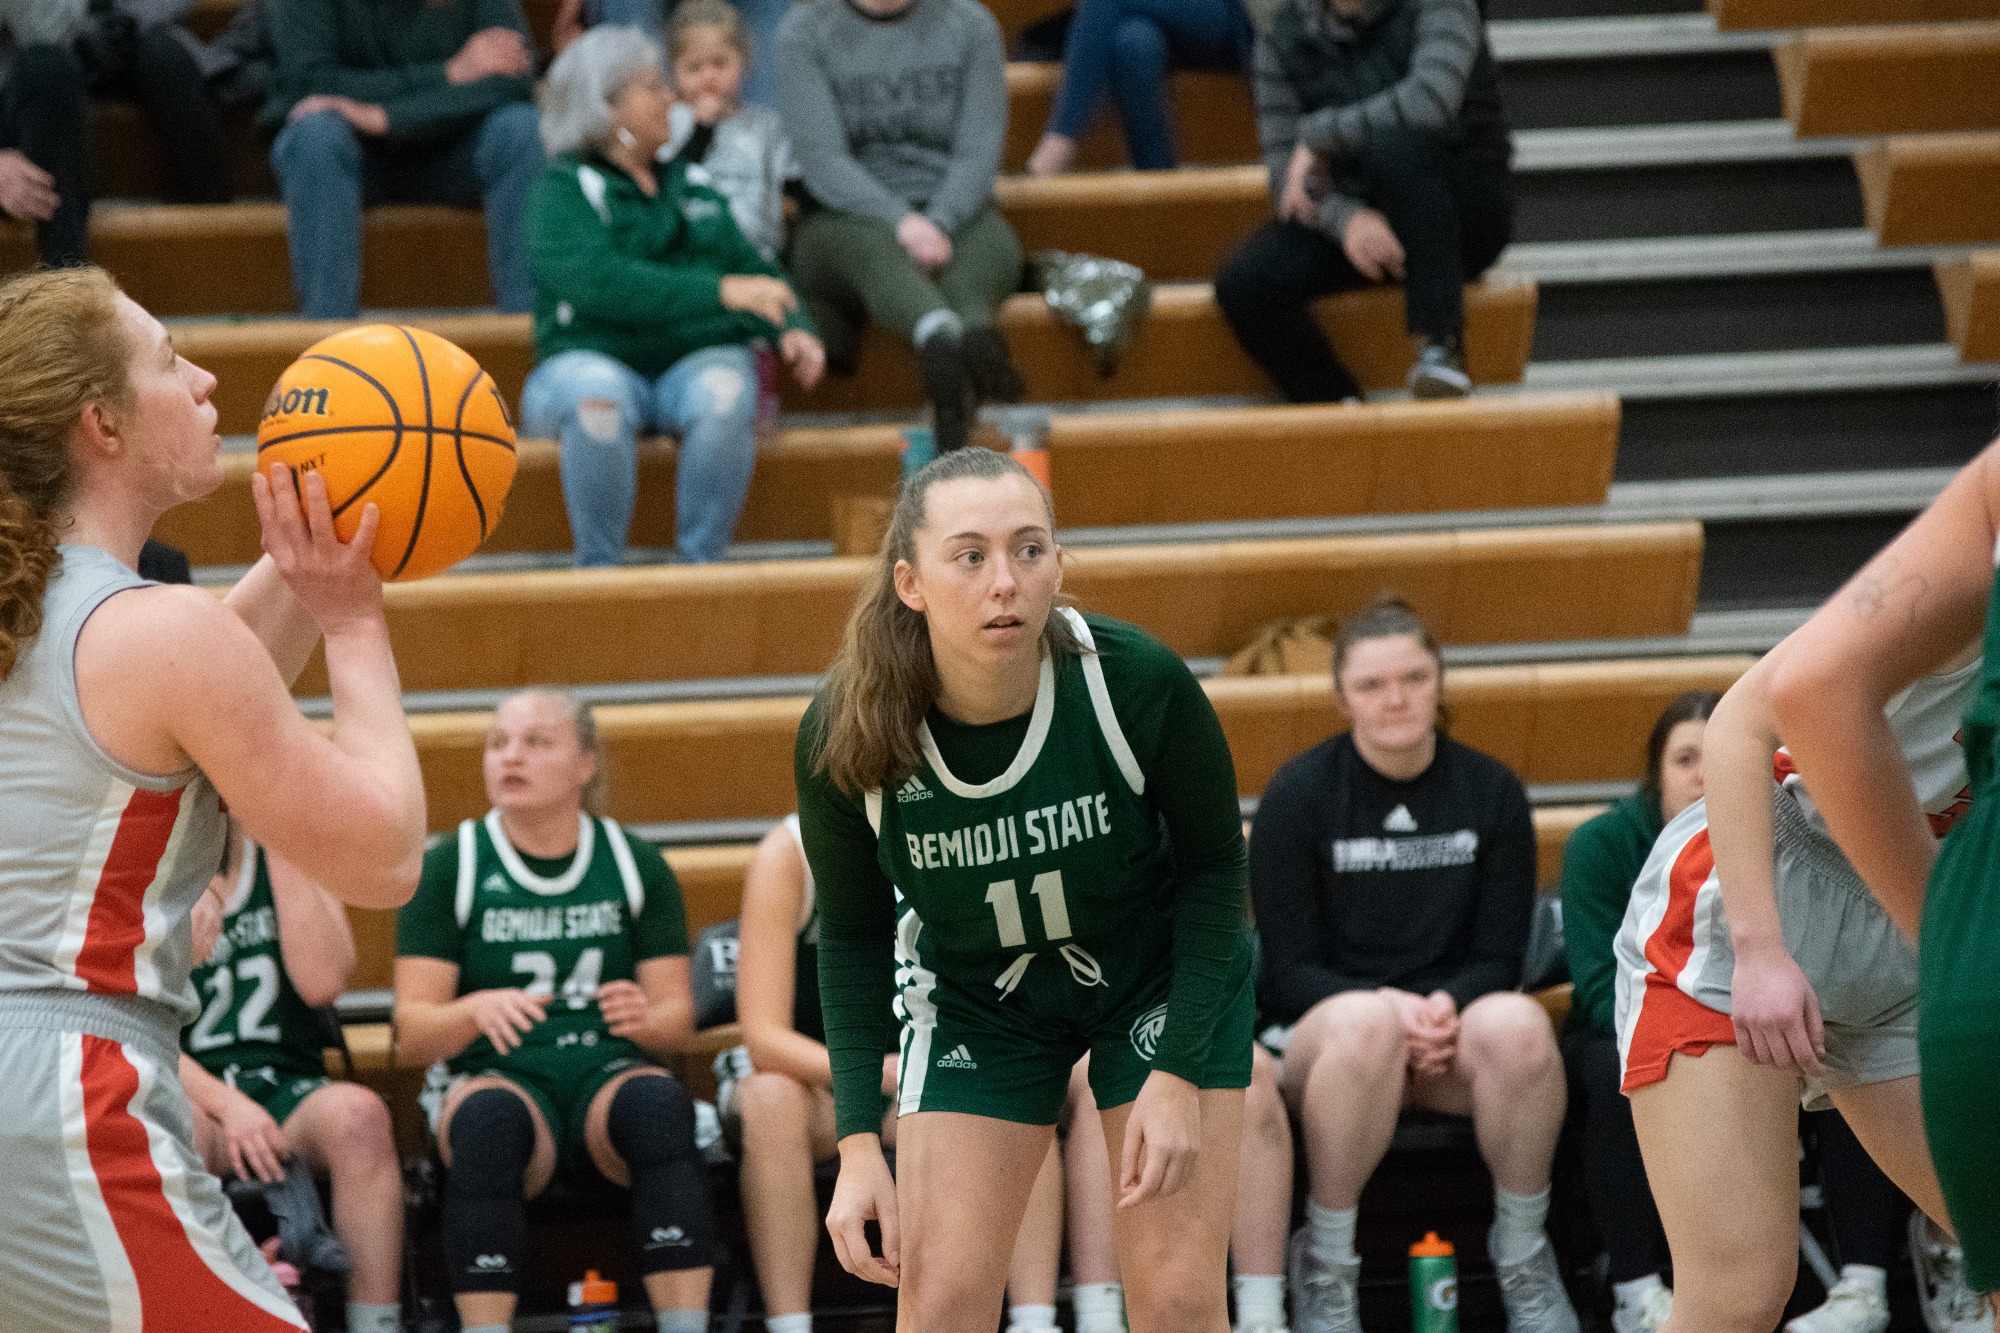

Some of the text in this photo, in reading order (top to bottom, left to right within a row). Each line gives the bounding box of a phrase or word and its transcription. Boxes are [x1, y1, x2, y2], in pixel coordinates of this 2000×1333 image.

[897, 790, 934, 803] adidas
[906, 791, 1111, 870] BEMIDJI STATE
[984, 869, 1072, 948] 11
[190, 954, 281, 1050] 22
[937, 1058, 977, 1069] adidas
